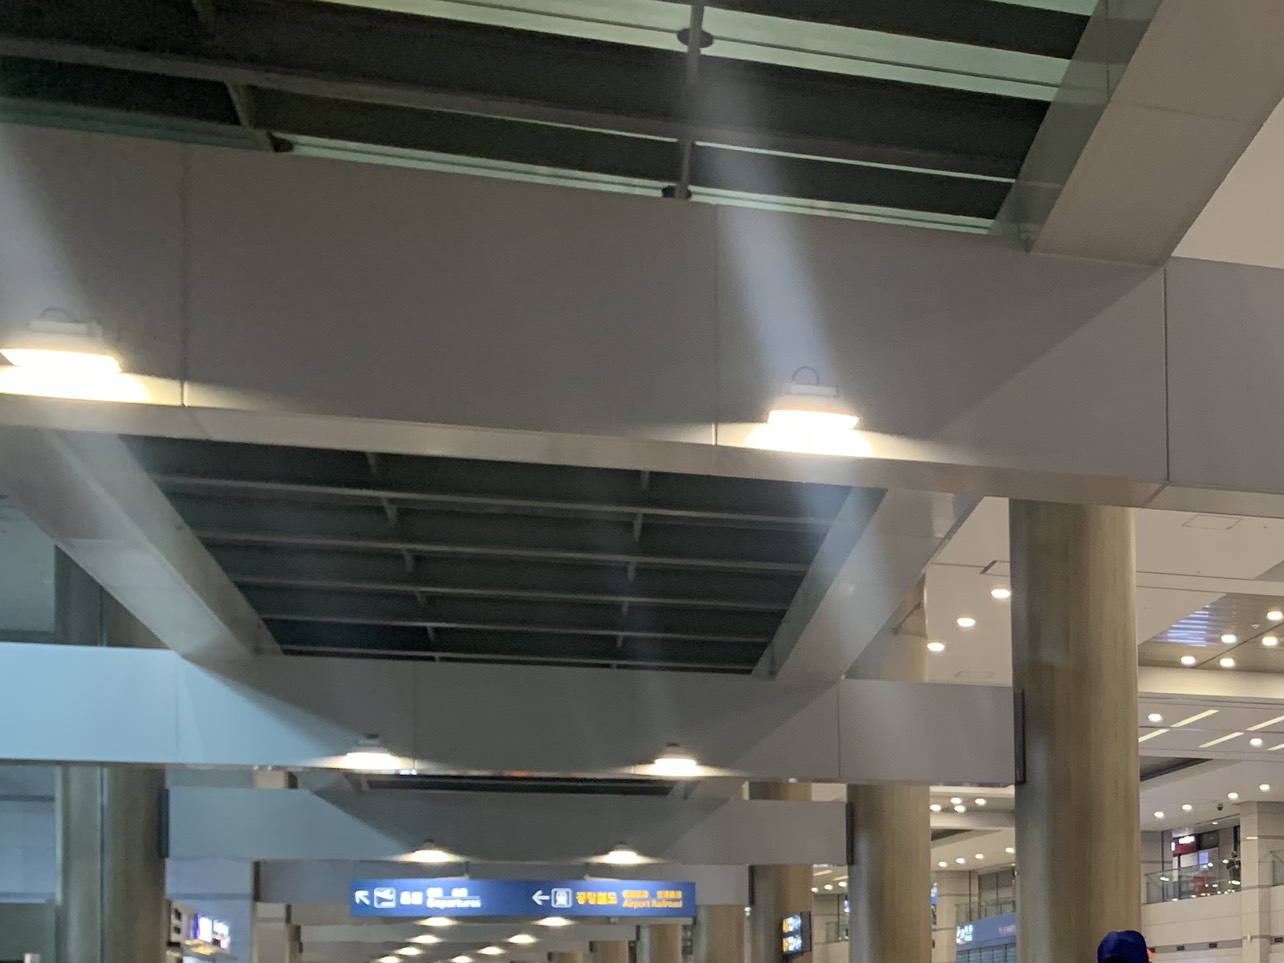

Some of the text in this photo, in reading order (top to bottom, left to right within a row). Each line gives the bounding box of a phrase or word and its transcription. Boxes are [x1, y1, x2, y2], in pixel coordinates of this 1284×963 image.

[427, 898, 481, 909] Departures
[622, 899, 682, 909] Airport Railroad
